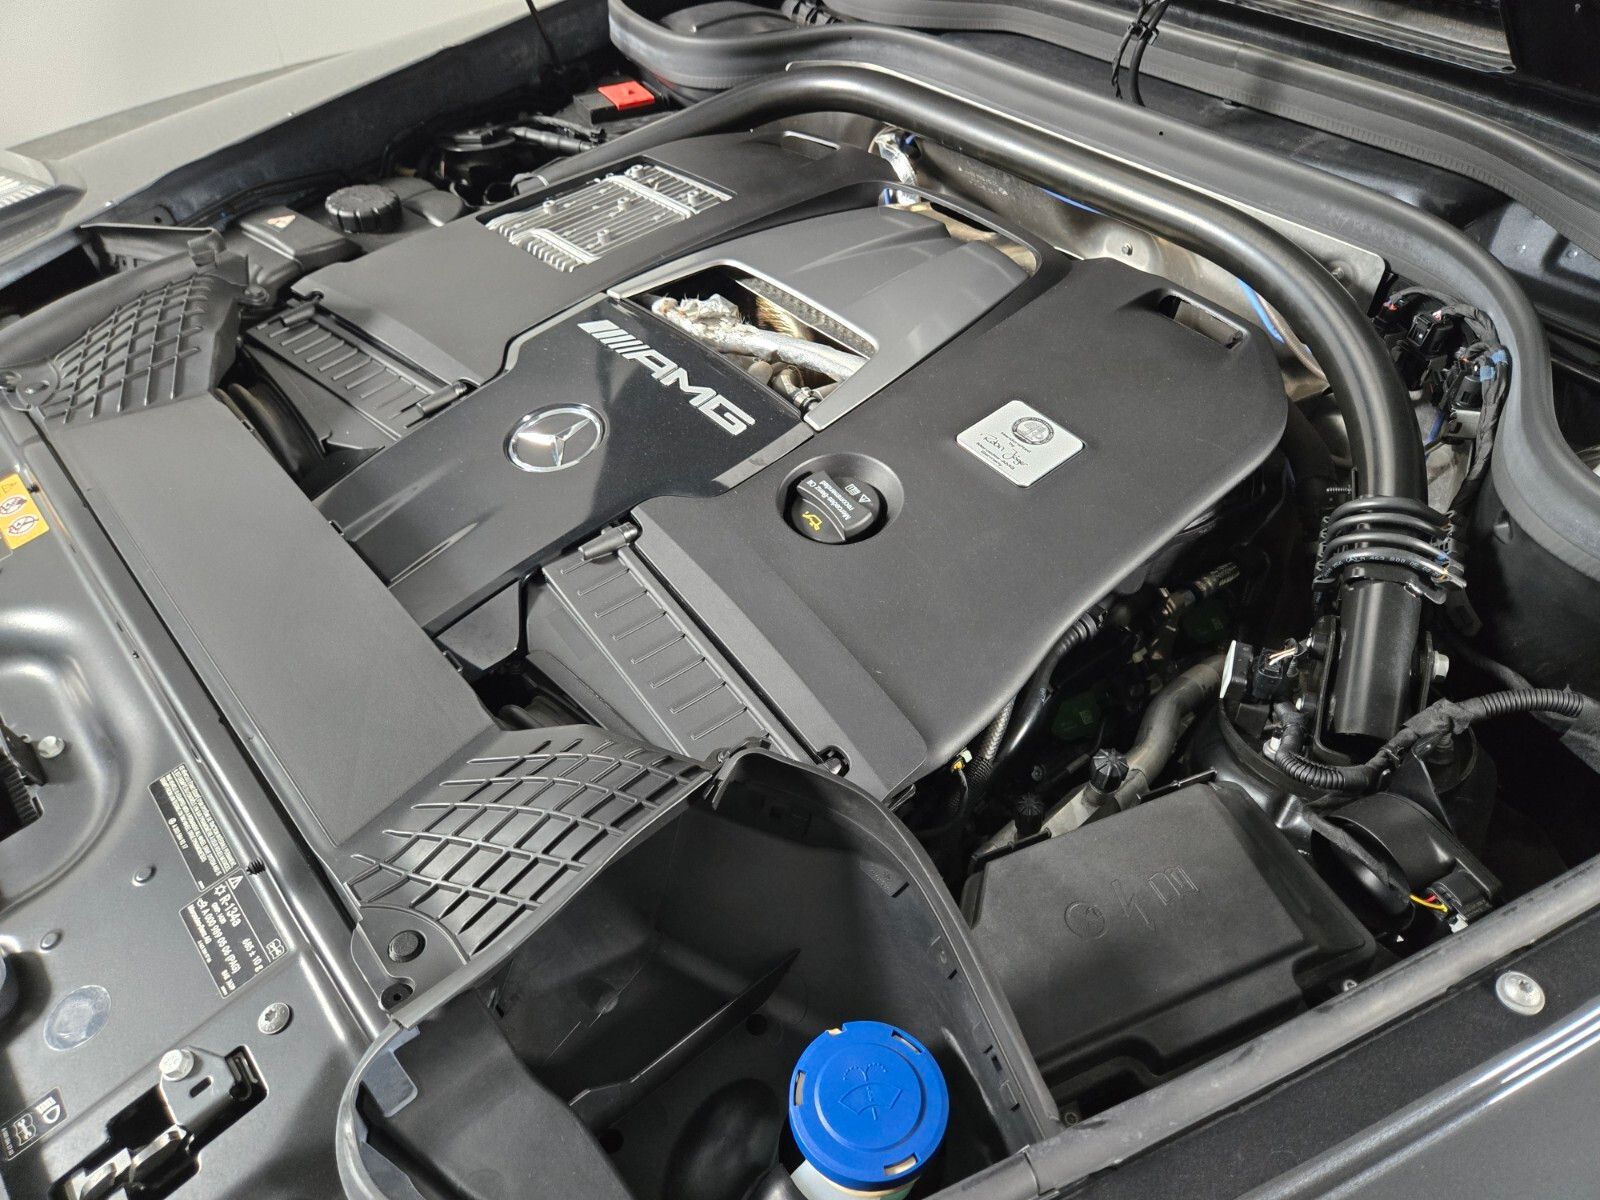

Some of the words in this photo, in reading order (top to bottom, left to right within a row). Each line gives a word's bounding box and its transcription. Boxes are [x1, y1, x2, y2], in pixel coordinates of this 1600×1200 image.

[622, 349, 756, 436] AMG
[815, 485, 852, 520] Mercedes-Benz
[219, 894, 242, 927] R-134a
[216, 936, 227, 947] 05
[221, 944, 232, 956] 06
[242, 938, 254, 952] 685
[224, 953, 241, 974] (PAG)
